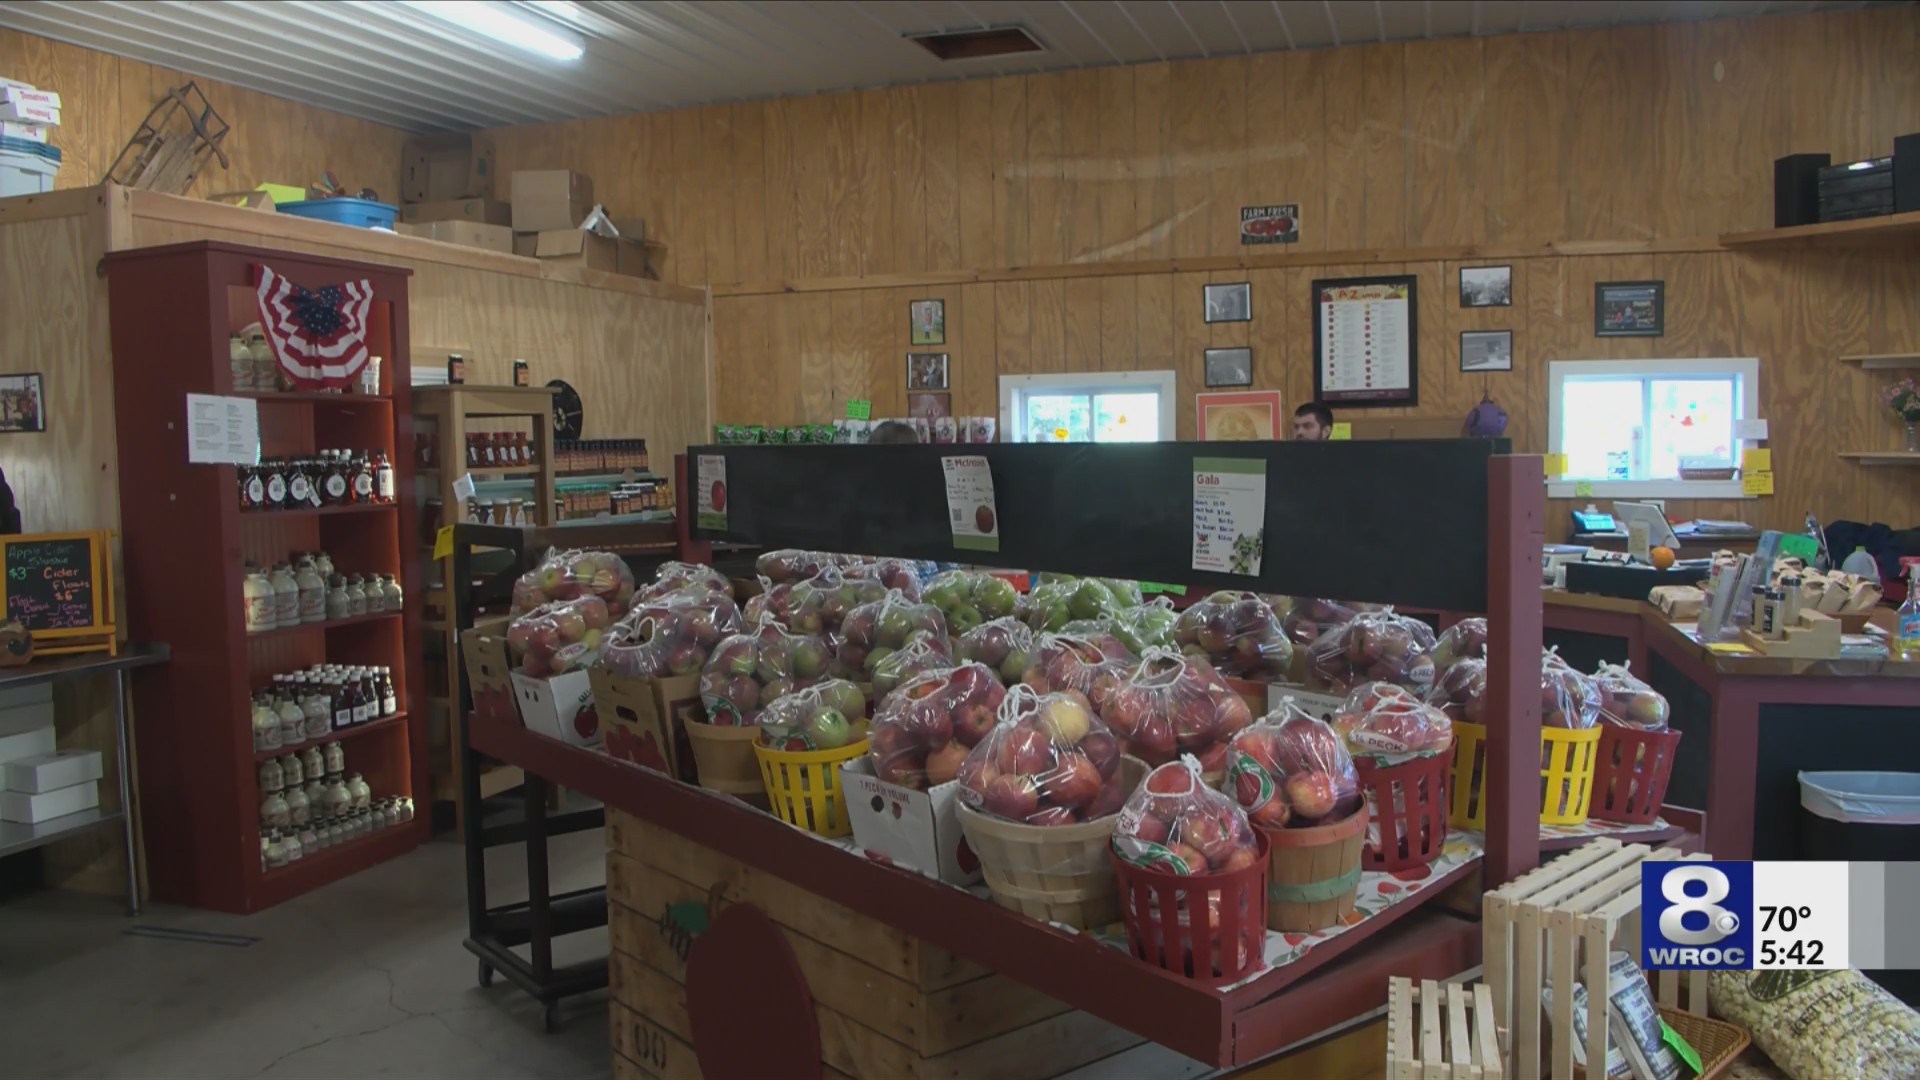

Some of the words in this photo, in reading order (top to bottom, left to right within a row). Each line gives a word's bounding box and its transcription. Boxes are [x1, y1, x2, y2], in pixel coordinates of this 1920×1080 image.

[1243, 207, 1266, 219] FARM
[1267, 206, 1294, 218] FRESH
[1196, 474, 1220, 486] Gala
[9, 545, 40, 560] Apple
[43, 566, 79, 580] Cider
[1368, 737, 1404, 752] PECK
